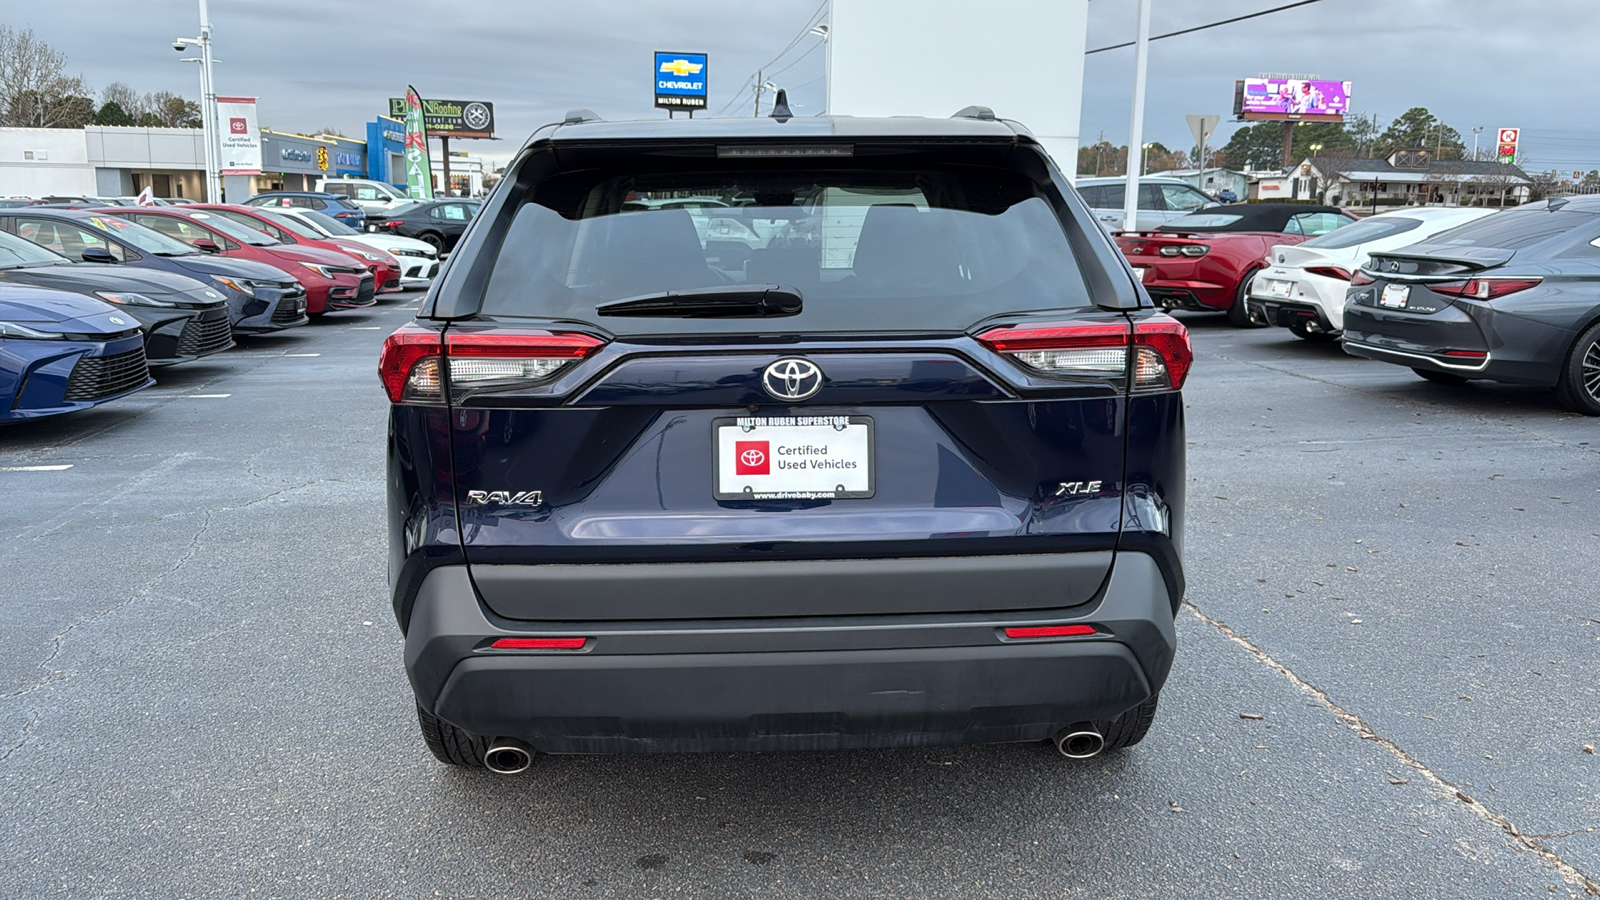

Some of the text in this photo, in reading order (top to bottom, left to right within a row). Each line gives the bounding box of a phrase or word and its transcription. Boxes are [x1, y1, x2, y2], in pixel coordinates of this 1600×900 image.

[658, 80, 703, 90] CHEVROLET
[658, 97, 704, 106] MILTON RUBEN
[433, 102, 462, 117] Roofing
[736, 416, 850, 426] MILTON RUBEN SUPERSTORE
[777, 445, 828, 456] Certified
[777, 458, 858, 470] Used Vehicles
[1055, 480, 1103, 496] XLE
[466, 490, 543, 507] RAV4
[753, 491, 836, 500] www.drivebaby.com
